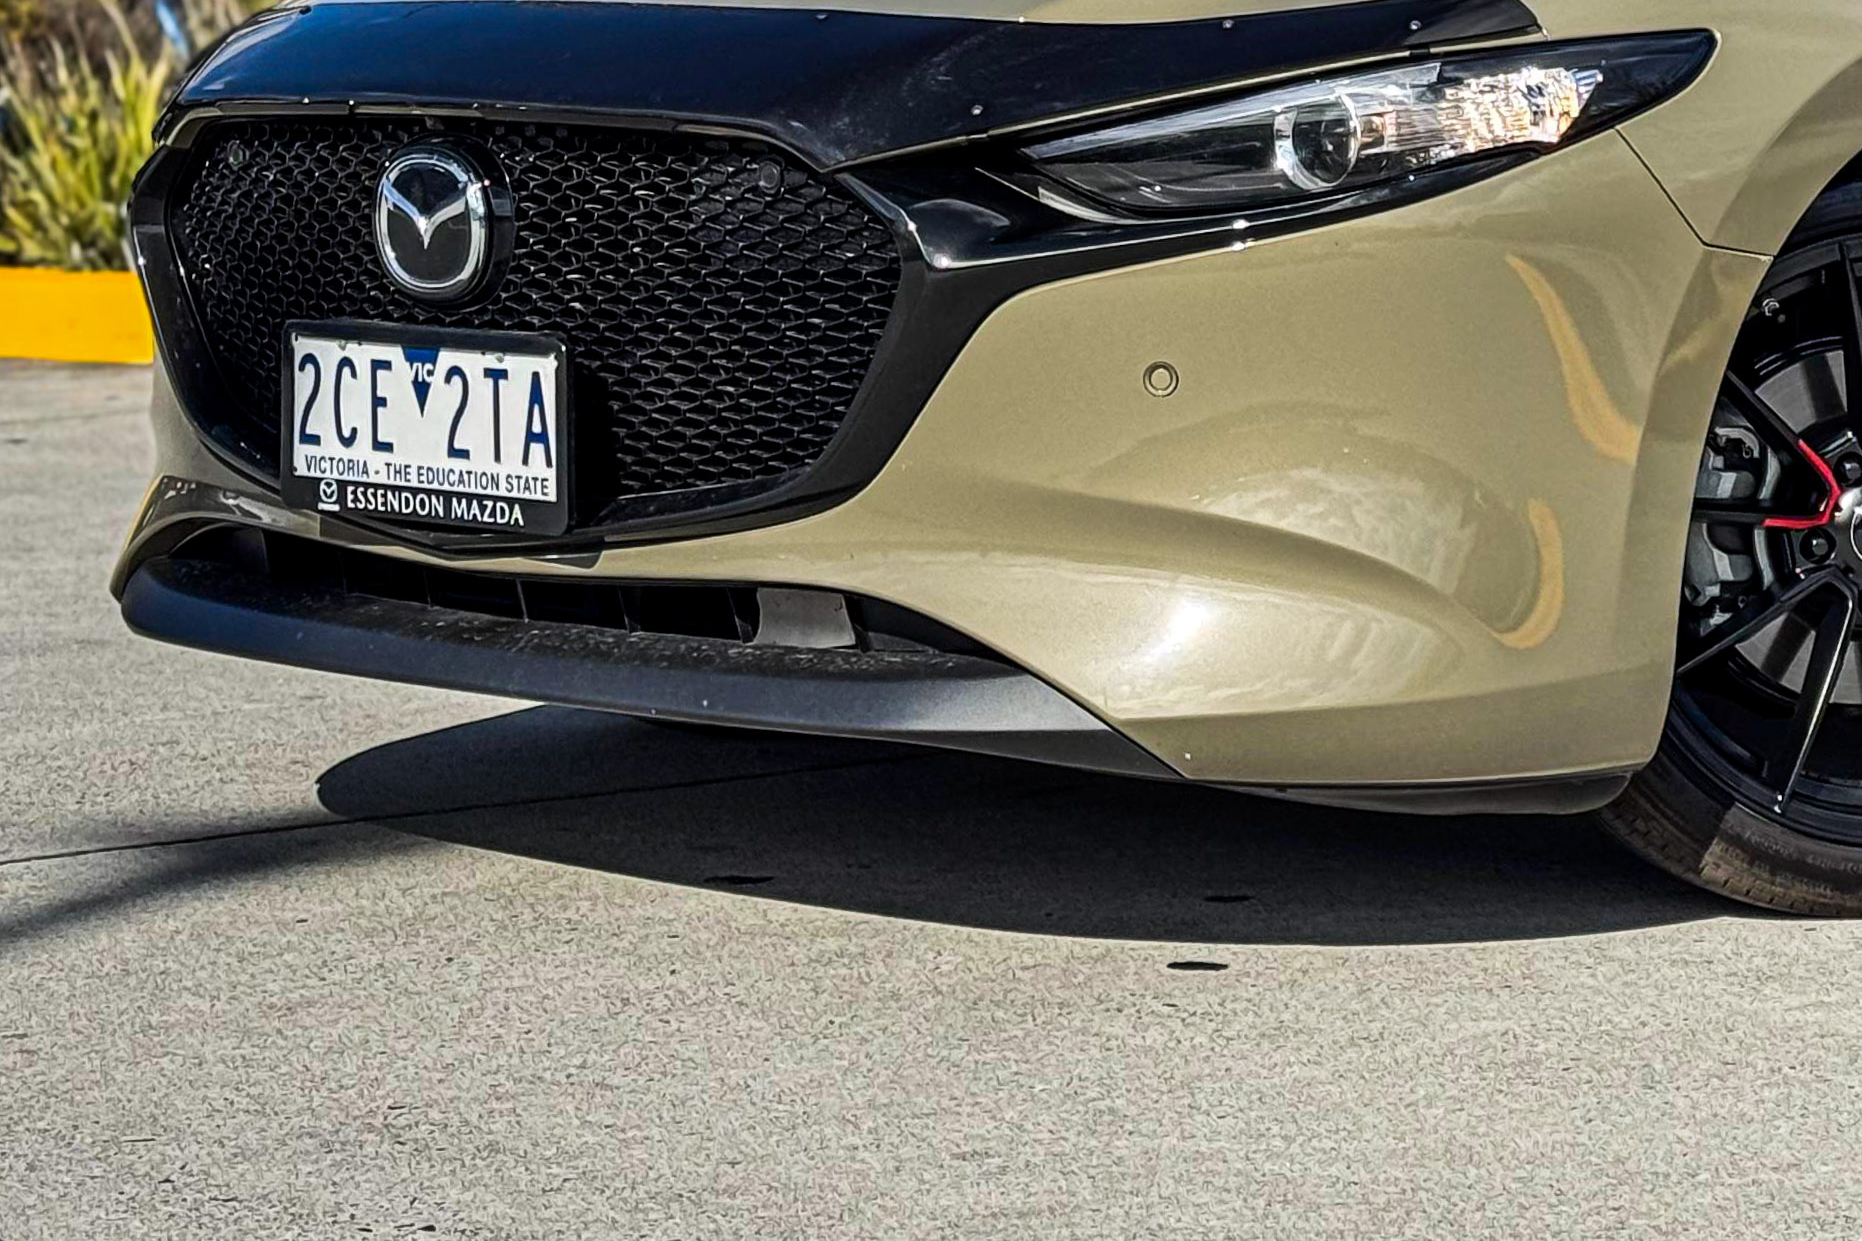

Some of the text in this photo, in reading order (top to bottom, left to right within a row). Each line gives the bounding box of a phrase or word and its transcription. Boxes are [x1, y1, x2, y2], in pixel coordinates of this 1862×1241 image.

[298, 352, 554, 469] 2CE 2TA
[304, 454, 370, 480] VICTORIA
[384, 462, 412, 484] THE
[416, 465, 500, 492] EDUCATION
[504, 478, 550, 497] STATE
[346, 485, 525, 527] ESSENDON MAZDA
